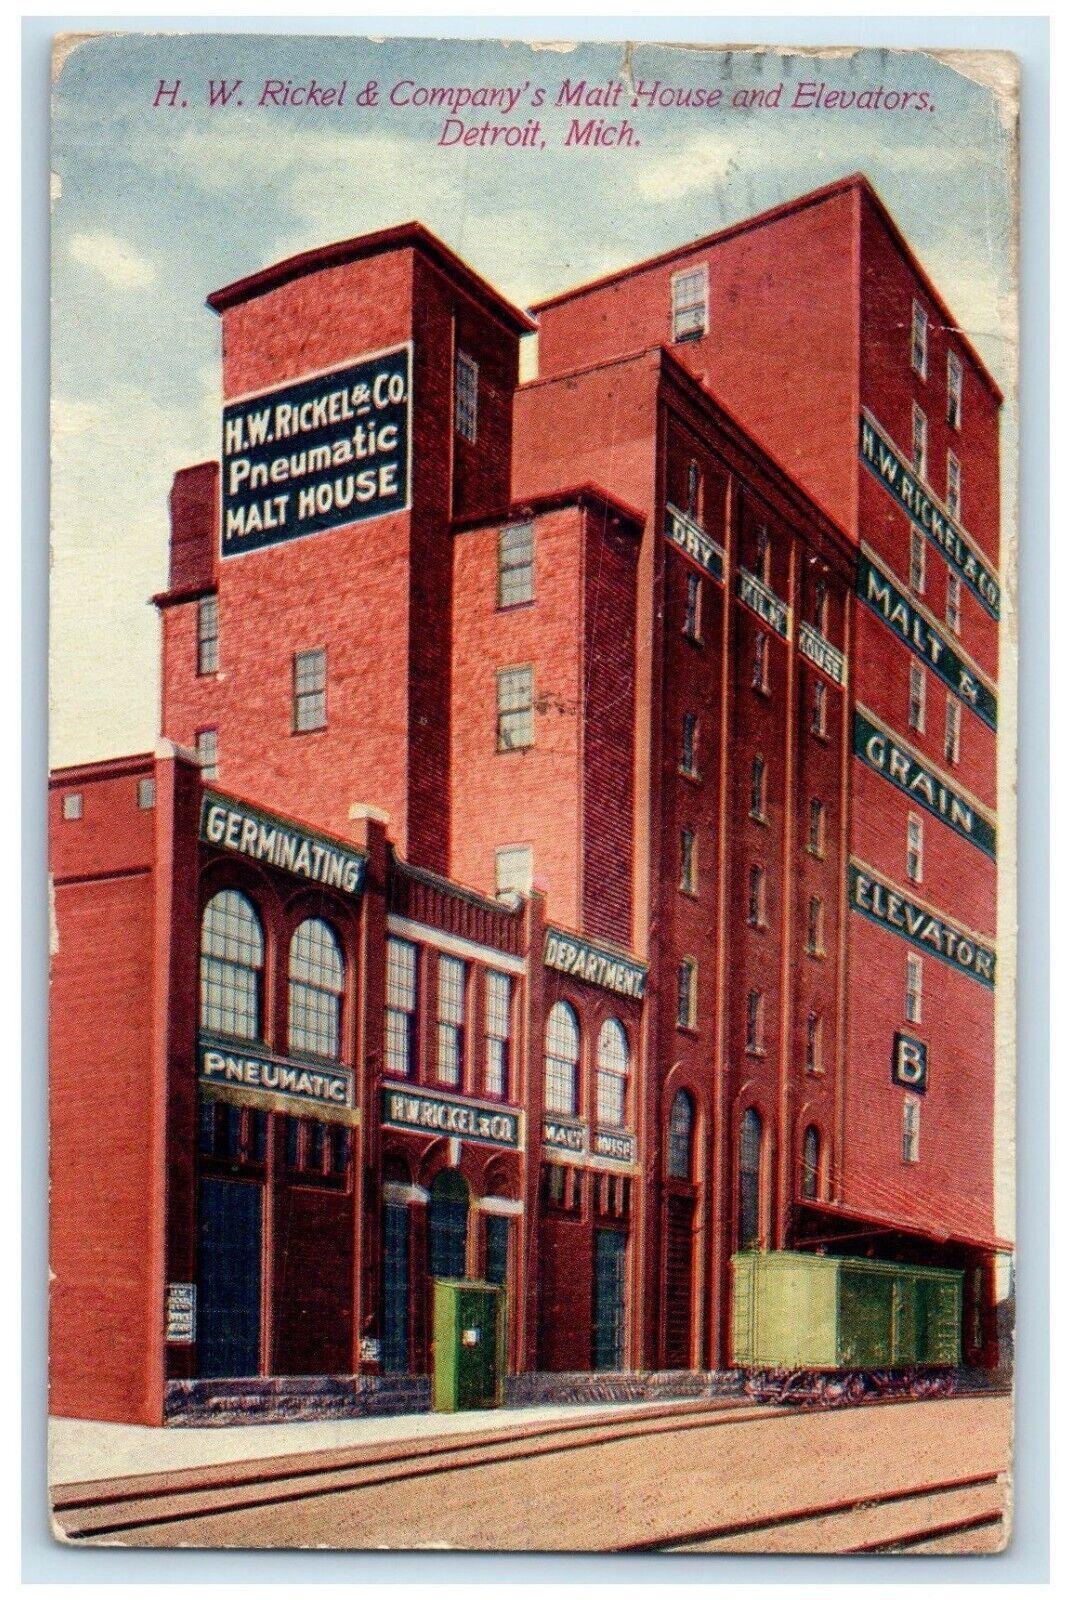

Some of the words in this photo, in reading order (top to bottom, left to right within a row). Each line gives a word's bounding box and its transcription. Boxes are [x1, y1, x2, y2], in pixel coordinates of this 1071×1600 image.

[229, 421, 399, 496] Pneumatic
[226, 494, 290, 541] MALT
[298, 464, 398, 520] HOUSE
[672, 518, 713, 568] DRY
[867, 571, 944, 665] MALT
[866, 735, 973, 834] GRAIN
[206, 805, 360, 893] GERMINATING
[855, 874, 995, 980] ELEVATOR
[204, 1051, 347, 1102] PNEUMATIC
[898, 1040, 922, 1083] B
